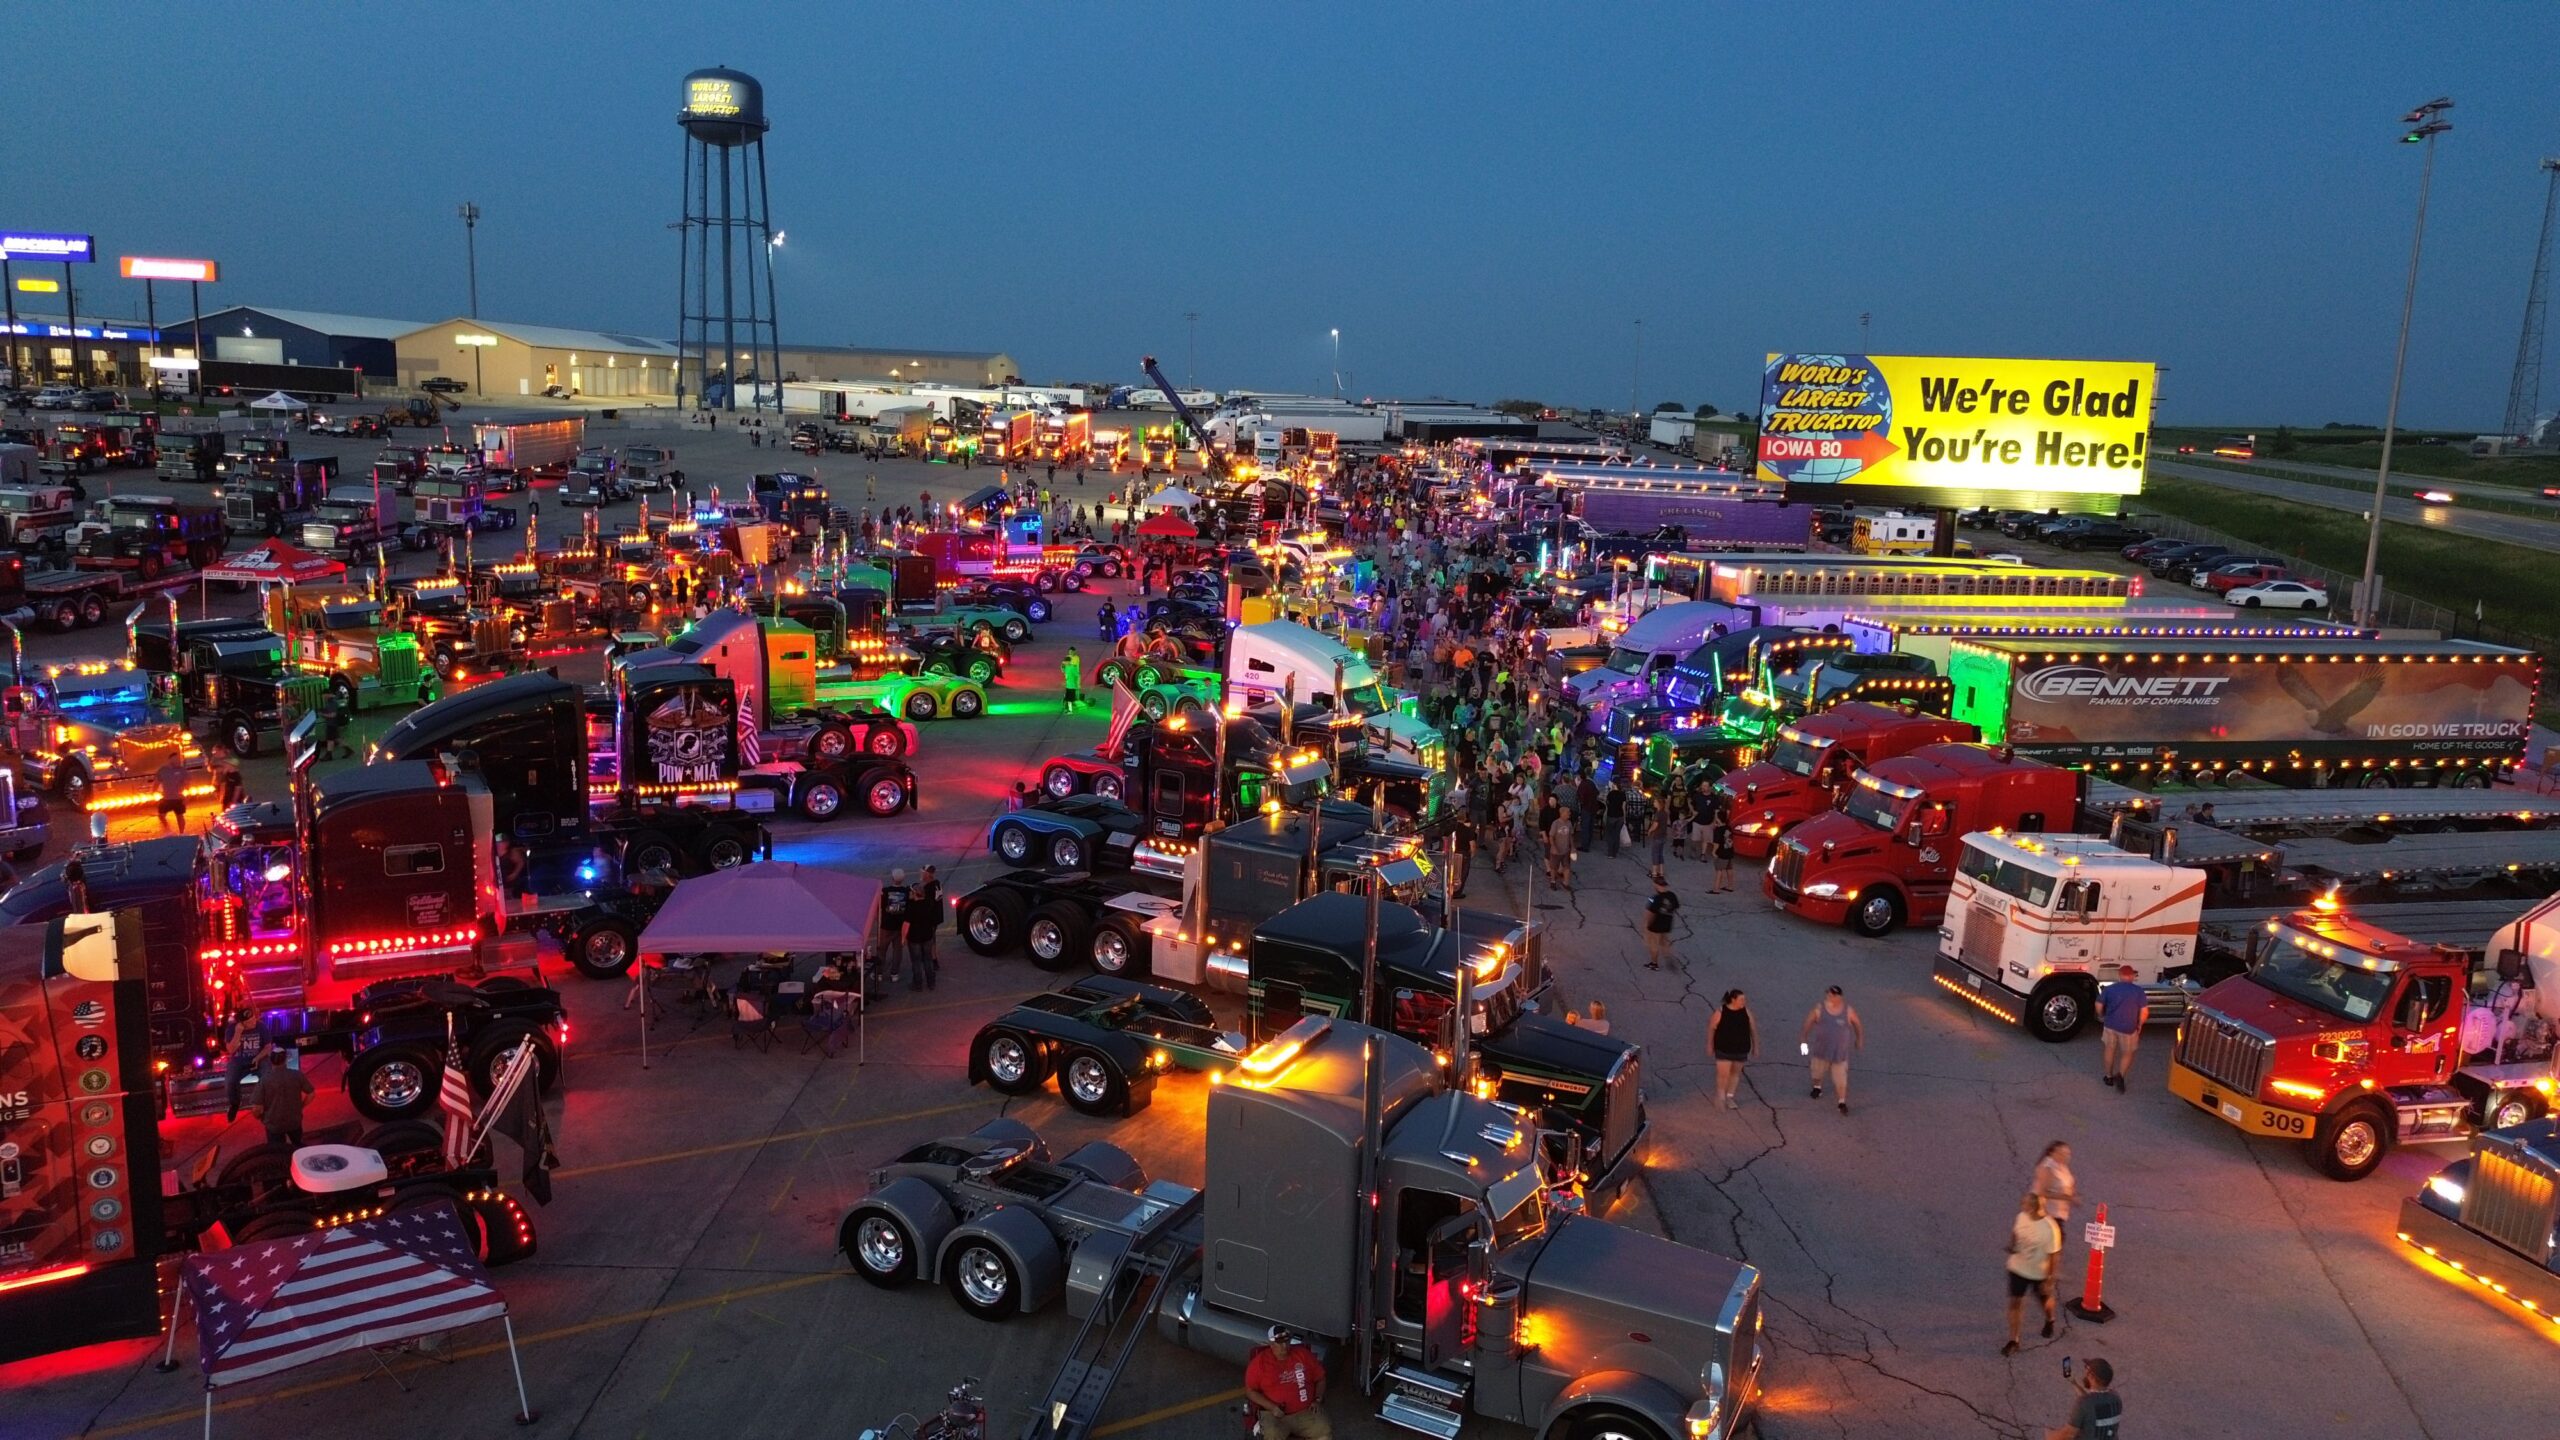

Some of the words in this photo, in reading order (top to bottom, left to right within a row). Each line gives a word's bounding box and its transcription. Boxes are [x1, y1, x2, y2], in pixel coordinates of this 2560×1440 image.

[692, 83, 730, 92] WORLD'S
[694, 93, 732, 103] LARGEST
[1779, 363, 1868, 385] WORLD'S
[1780, 389, 1868, 408] LARGEST
[1920, 377, 2030, 415] We're
[2043, 378, 2139, 418] Glad
[1767, 412, 1882, 432] TRUCKSTOP
[1766, 440, 1815, 457] IOWA
[1819, 442, 1842, 457] 80
[1903, 426, 2022, 464] You're
[2035, 431, 2146, 470] Here!
[1244, 672, 1260, 680] 420
[2038, 677, 2230, 696] BENNETT
[2088, 697, 2130, 706] FAMILY
[2132, 697, 2154, 706] OF
[2155, 697, 2221, 706] COMPANIES
[2367, 724, 2386, 738] IN
[2389, 724, 2428, 738] GOD
[2432, 724, 2460, 737] WE
[2463, 723, 2521, 736] TRUCK
[2413, 742, 2440, 750] HOME
[2441, 742, 2453, 750] OF
[2456, 741, 2473, 749] THE
[2474, 741, 2506, 750] GOOSE
[659, 763, 684, 783] POW
[694, 761, 719, 782] MIA
[2319, 1030, 2363, 1042] 2230923
[2262, 1111, 2305, 1134] 309
